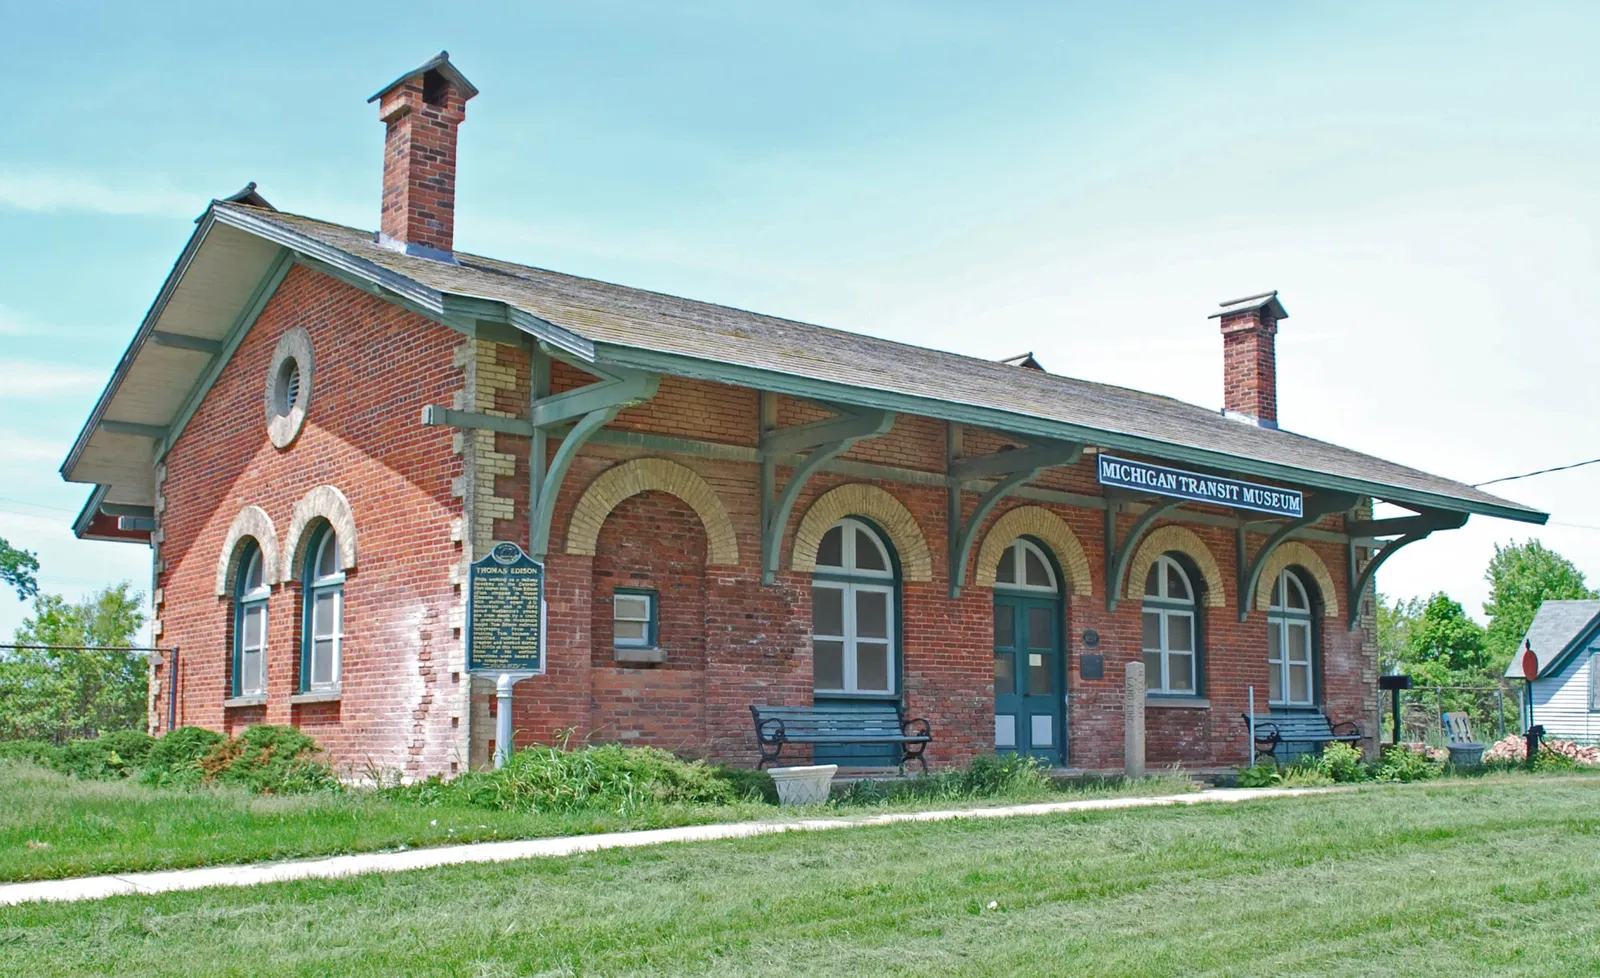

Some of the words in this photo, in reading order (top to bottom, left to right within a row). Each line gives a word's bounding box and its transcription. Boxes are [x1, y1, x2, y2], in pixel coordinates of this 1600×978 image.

[1102, 461, 1177, 490] MICHIGAN
[1178, 476, 1240, 501] TRANSIT
[1242, 487, 1301, 512] MUSEUM
[510, 567, 538, 575] EDISON
